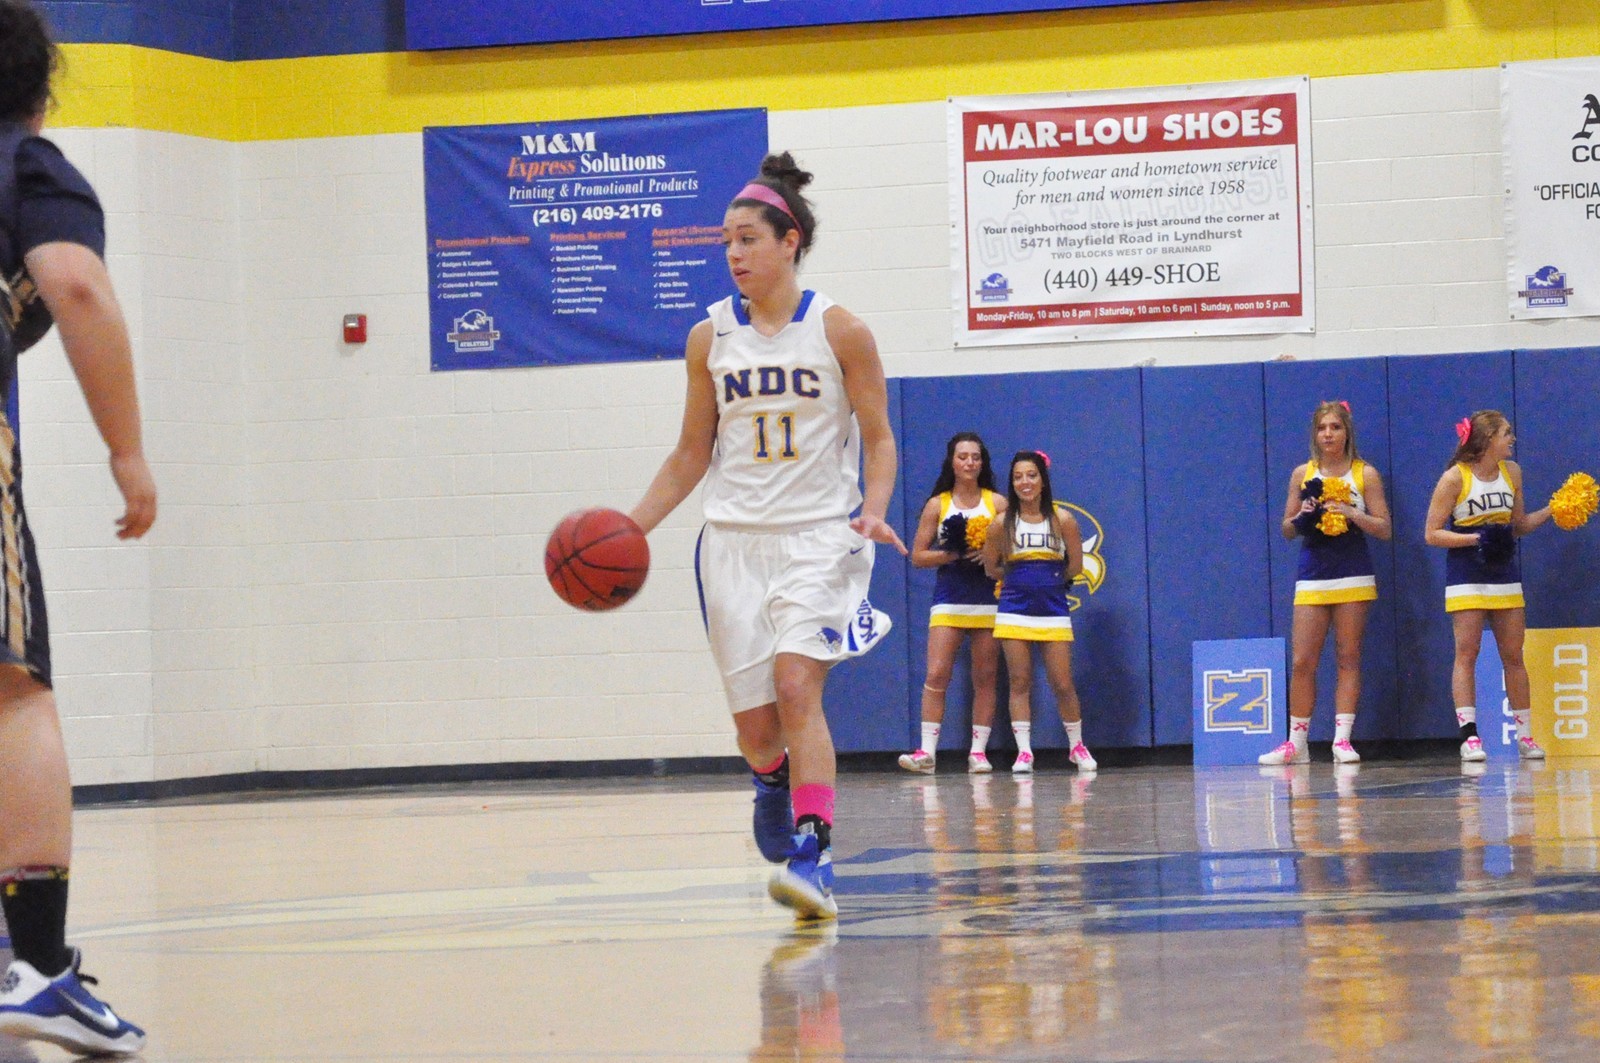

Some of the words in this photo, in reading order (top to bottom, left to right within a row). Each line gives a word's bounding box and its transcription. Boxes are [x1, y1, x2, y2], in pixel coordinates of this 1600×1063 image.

[975, 116, 1148, 151] MAR-LOU
[1162, 108, 1283, 141] SHOES
[521, 132, 597, 155] M&M
[507, 157, 576, 182] Express
[580, 152, 666, 174] Solutions
[983, 168, 1038, 187] Quality
[1040, 166, 1107, 186] footwear
[1110, 162, 1140, 178] and
[1144, 162, 1222, 176] hometown
[1226, 156, 1278, 172] service
[509, 185, 555, 202] Printing
[560, 184, 569, 198] &
[574, 180, 643, 197] Promotional
[650, 178, 699, 193] Products
[1012, 190, 1036, 210] for
[1040, 193, 1072, 204] men
[1076, 186, 1106, 201] and
[1110, 187, 1162, 200] women
[1168, 183, 1204, 197] since
[1210, 180, 1245, 195] 1958
[533, 208, 577, 227] (216)
[582, 203, 662, 220] 409-2176
[984, 226, 1007, 235] Your
[1011, 222, 1087, 235] neighborhood
[1090, 220, 1120, 230] store
[1123, 219, 1133, 228] is
[1136, 218, 1158, 229] just
[1162, 216, 1200, 226] around
[1204, 215, 1223, 224] the
[1226, 214, 1264, 223] corner
[1268, 212, 1280, 220] at
[1020, 238, 1050, 249] 5471
[1057, 235, 1114, 249] Mayfield
[1120, 232, 1152, 244] Road
[1158, 232, 1169, 242] in
[1174, 228, 1242, 244] Lyndhurst
[1051, 252, 1072, 260] TWO
[1075, 250, 1113, 258] BLOCKS
[1116, 248, 1142, 256] WEST
[1162, 245, 1212, 254] BRAINARD
[1044, 266, 1098, 294] (440)
[1106, 262, 1221, 287] 449-SHOE
[976, 311, 1035, 322] Monday-Friday,
[1037, 311, 1046, 319] 10
[1048, 311, 1060, 319] am
[1062, 310, 1070, 318] to
[1071, 309, 1077, 317] 8
[1078, 311, 1091, 320] pm
[1100, 307, 1135, 318] Saturday,
[1137, 306, 1147, 314] 10
[1172, 304, 1178, 312] 6
[1180, 306, 1192, 315] pm
[1201, 302, 1232, 312] Sunday,
[1234, 302, 1254, 310] noon
[1256, 301, 1264, 309] to
[1266, 300, 1271, 308] 5
[1273, 301, 1290, 312] p.m.
[724, 366, 820, 403] NDC
[752, 412, 799, 462] 11
[1467, 492, 1513, 515] NDC
[1554, 644, 1588, 739] GOLD
